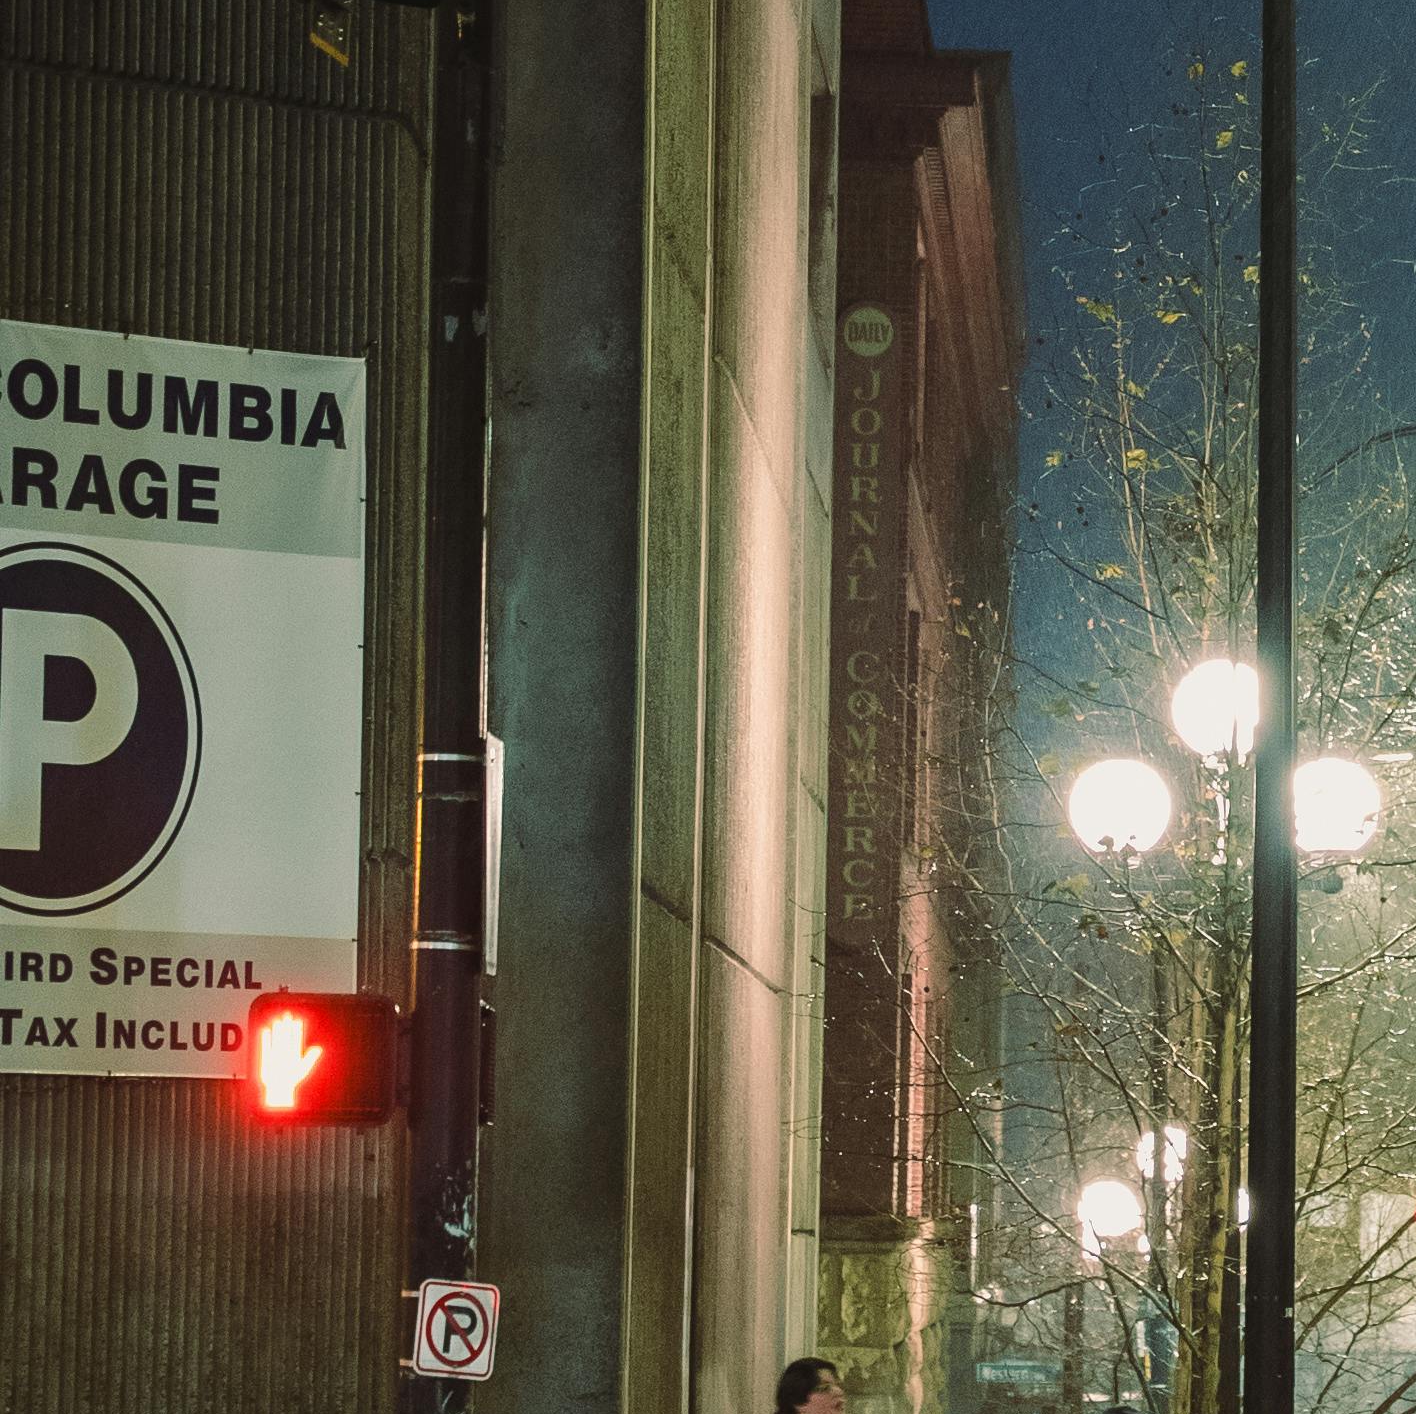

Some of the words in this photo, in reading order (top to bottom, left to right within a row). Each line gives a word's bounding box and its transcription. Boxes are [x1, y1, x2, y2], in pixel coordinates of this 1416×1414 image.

[848, 321, 891, 344] DAILY
[0, 358, 347, 450] OLUMBIA
[0, 446, 221, 525] RAGE
[848, 368, 882, 601] JOURNAL
[1, 607, 139, 851] P
[843, 650, 881, 920] COMMERCE
[4, 951, 73, 983] IRD
[95, 1012, 244, 1052] INCLUD
